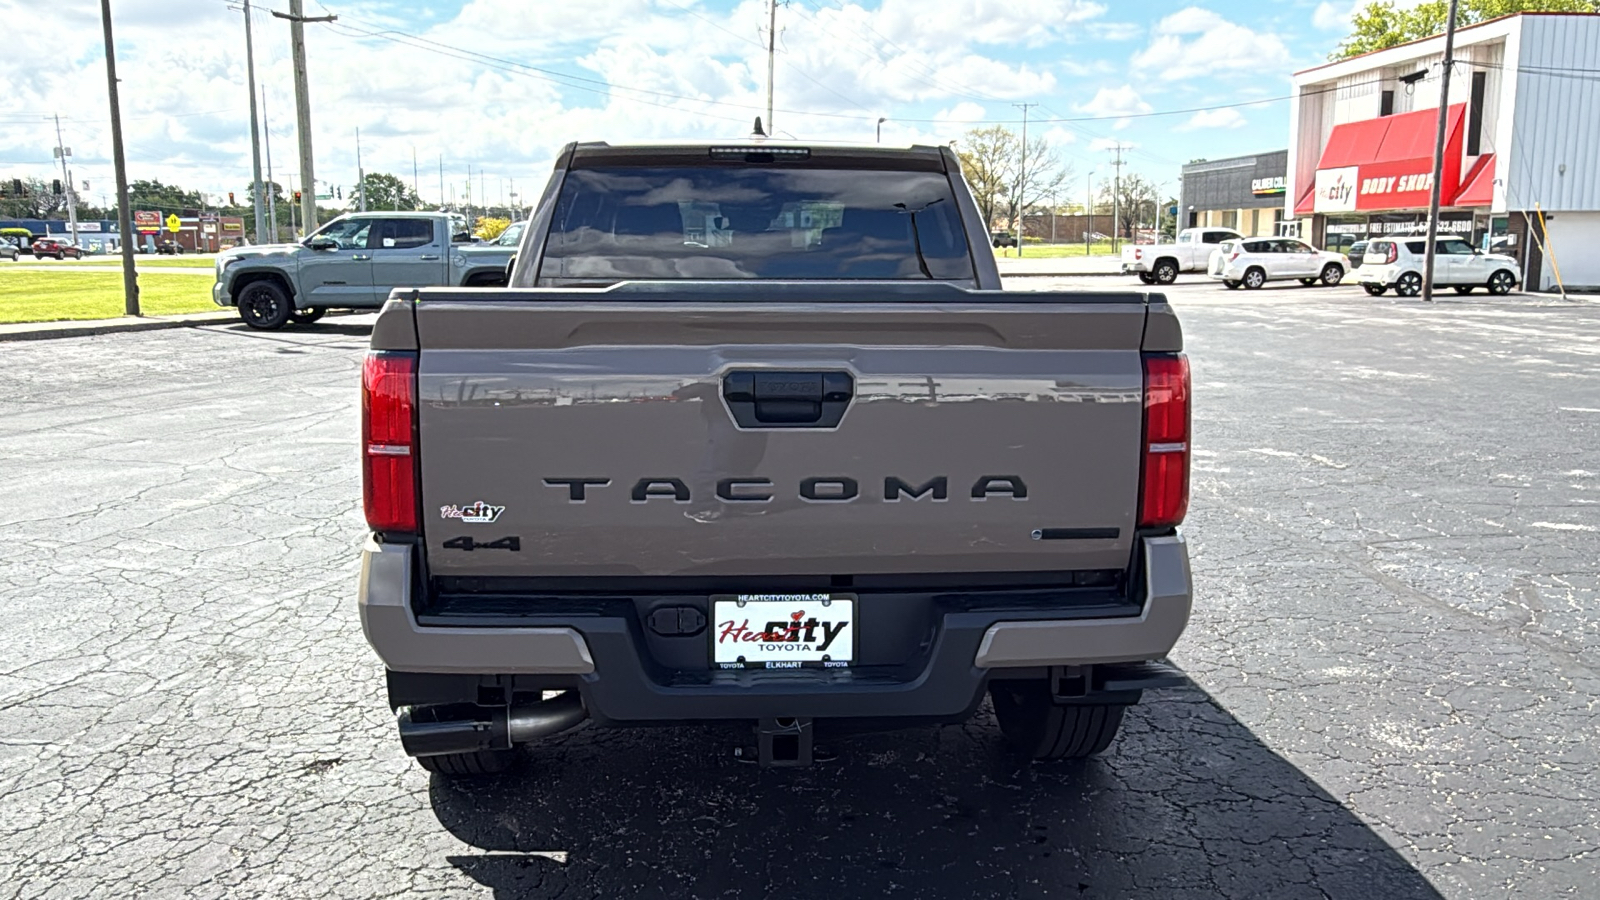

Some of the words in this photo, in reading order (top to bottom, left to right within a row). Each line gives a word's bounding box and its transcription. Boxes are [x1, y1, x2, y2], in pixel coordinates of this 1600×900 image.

[1328, 174, 1353, 205] city
[1360, 176, 1397, 195] BODY
[1397, 172, 1434, 193] SHOP
[1369, 222, 1382, 233] FREE
[542, 474, 1029, 504] TACOMA
[718, 618, 811, 644] Heart
[762, 610, 849, 651] city
